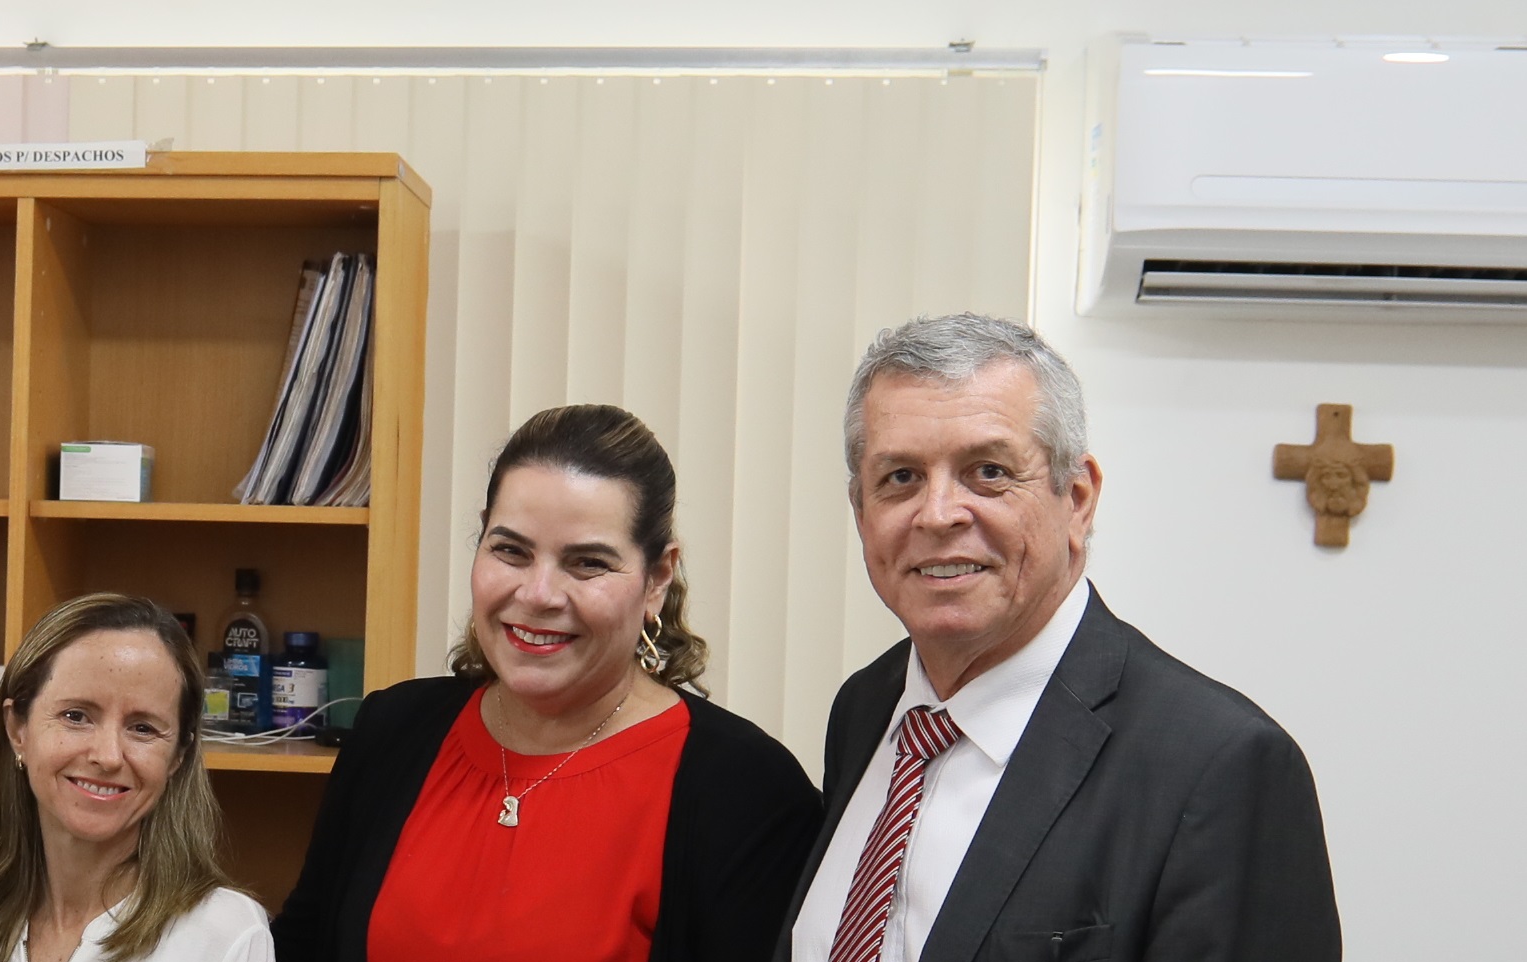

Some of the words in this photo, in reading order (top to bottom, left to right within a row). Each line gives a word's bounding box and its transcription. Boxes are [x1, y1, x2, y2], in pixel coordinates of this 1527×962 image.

[16, 150, 29, 163] P/
[33, 149, 125, 163] DESPACHOS
[229, 627, 256, 638] AUTO
[225, 637, 259, 648] CRAFT
